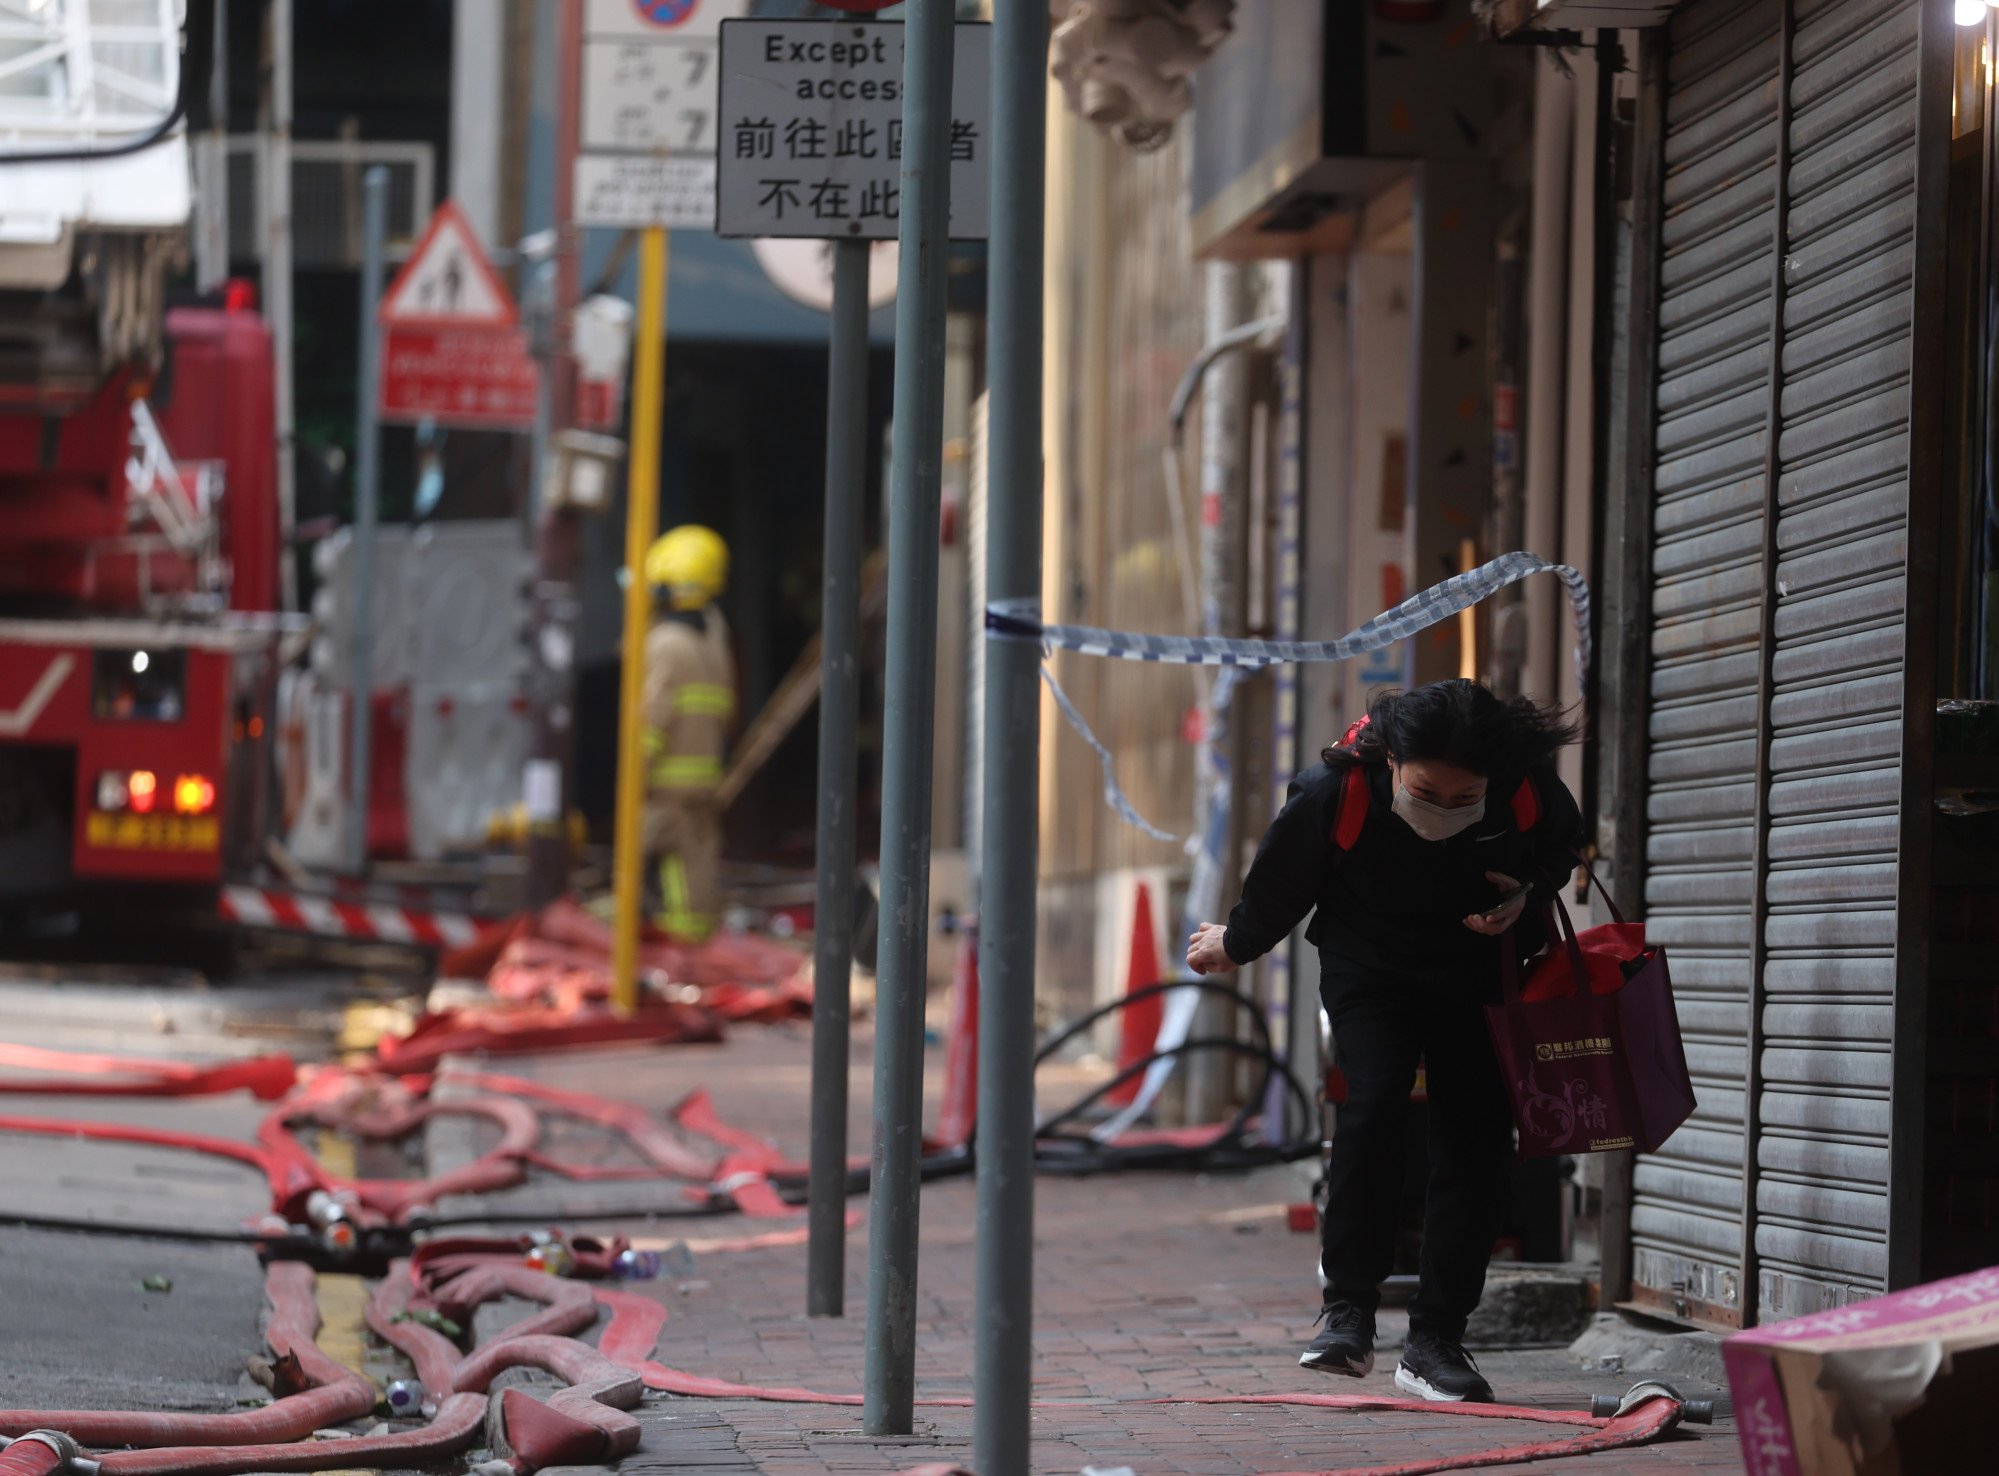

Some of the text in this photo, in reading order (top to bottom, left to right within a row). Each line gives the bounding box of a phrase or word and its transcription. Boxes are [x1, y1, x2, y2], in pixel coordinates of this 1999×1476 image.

[680, 50, 710, 90] 7
[764, 34, 886, 68] Except
[796, 78, 904, 101] acces
[678, 109, 709, 149] 7
[758, 178, 951, 220] 不在此
[1576, 1094, 1608, 1130] 情
